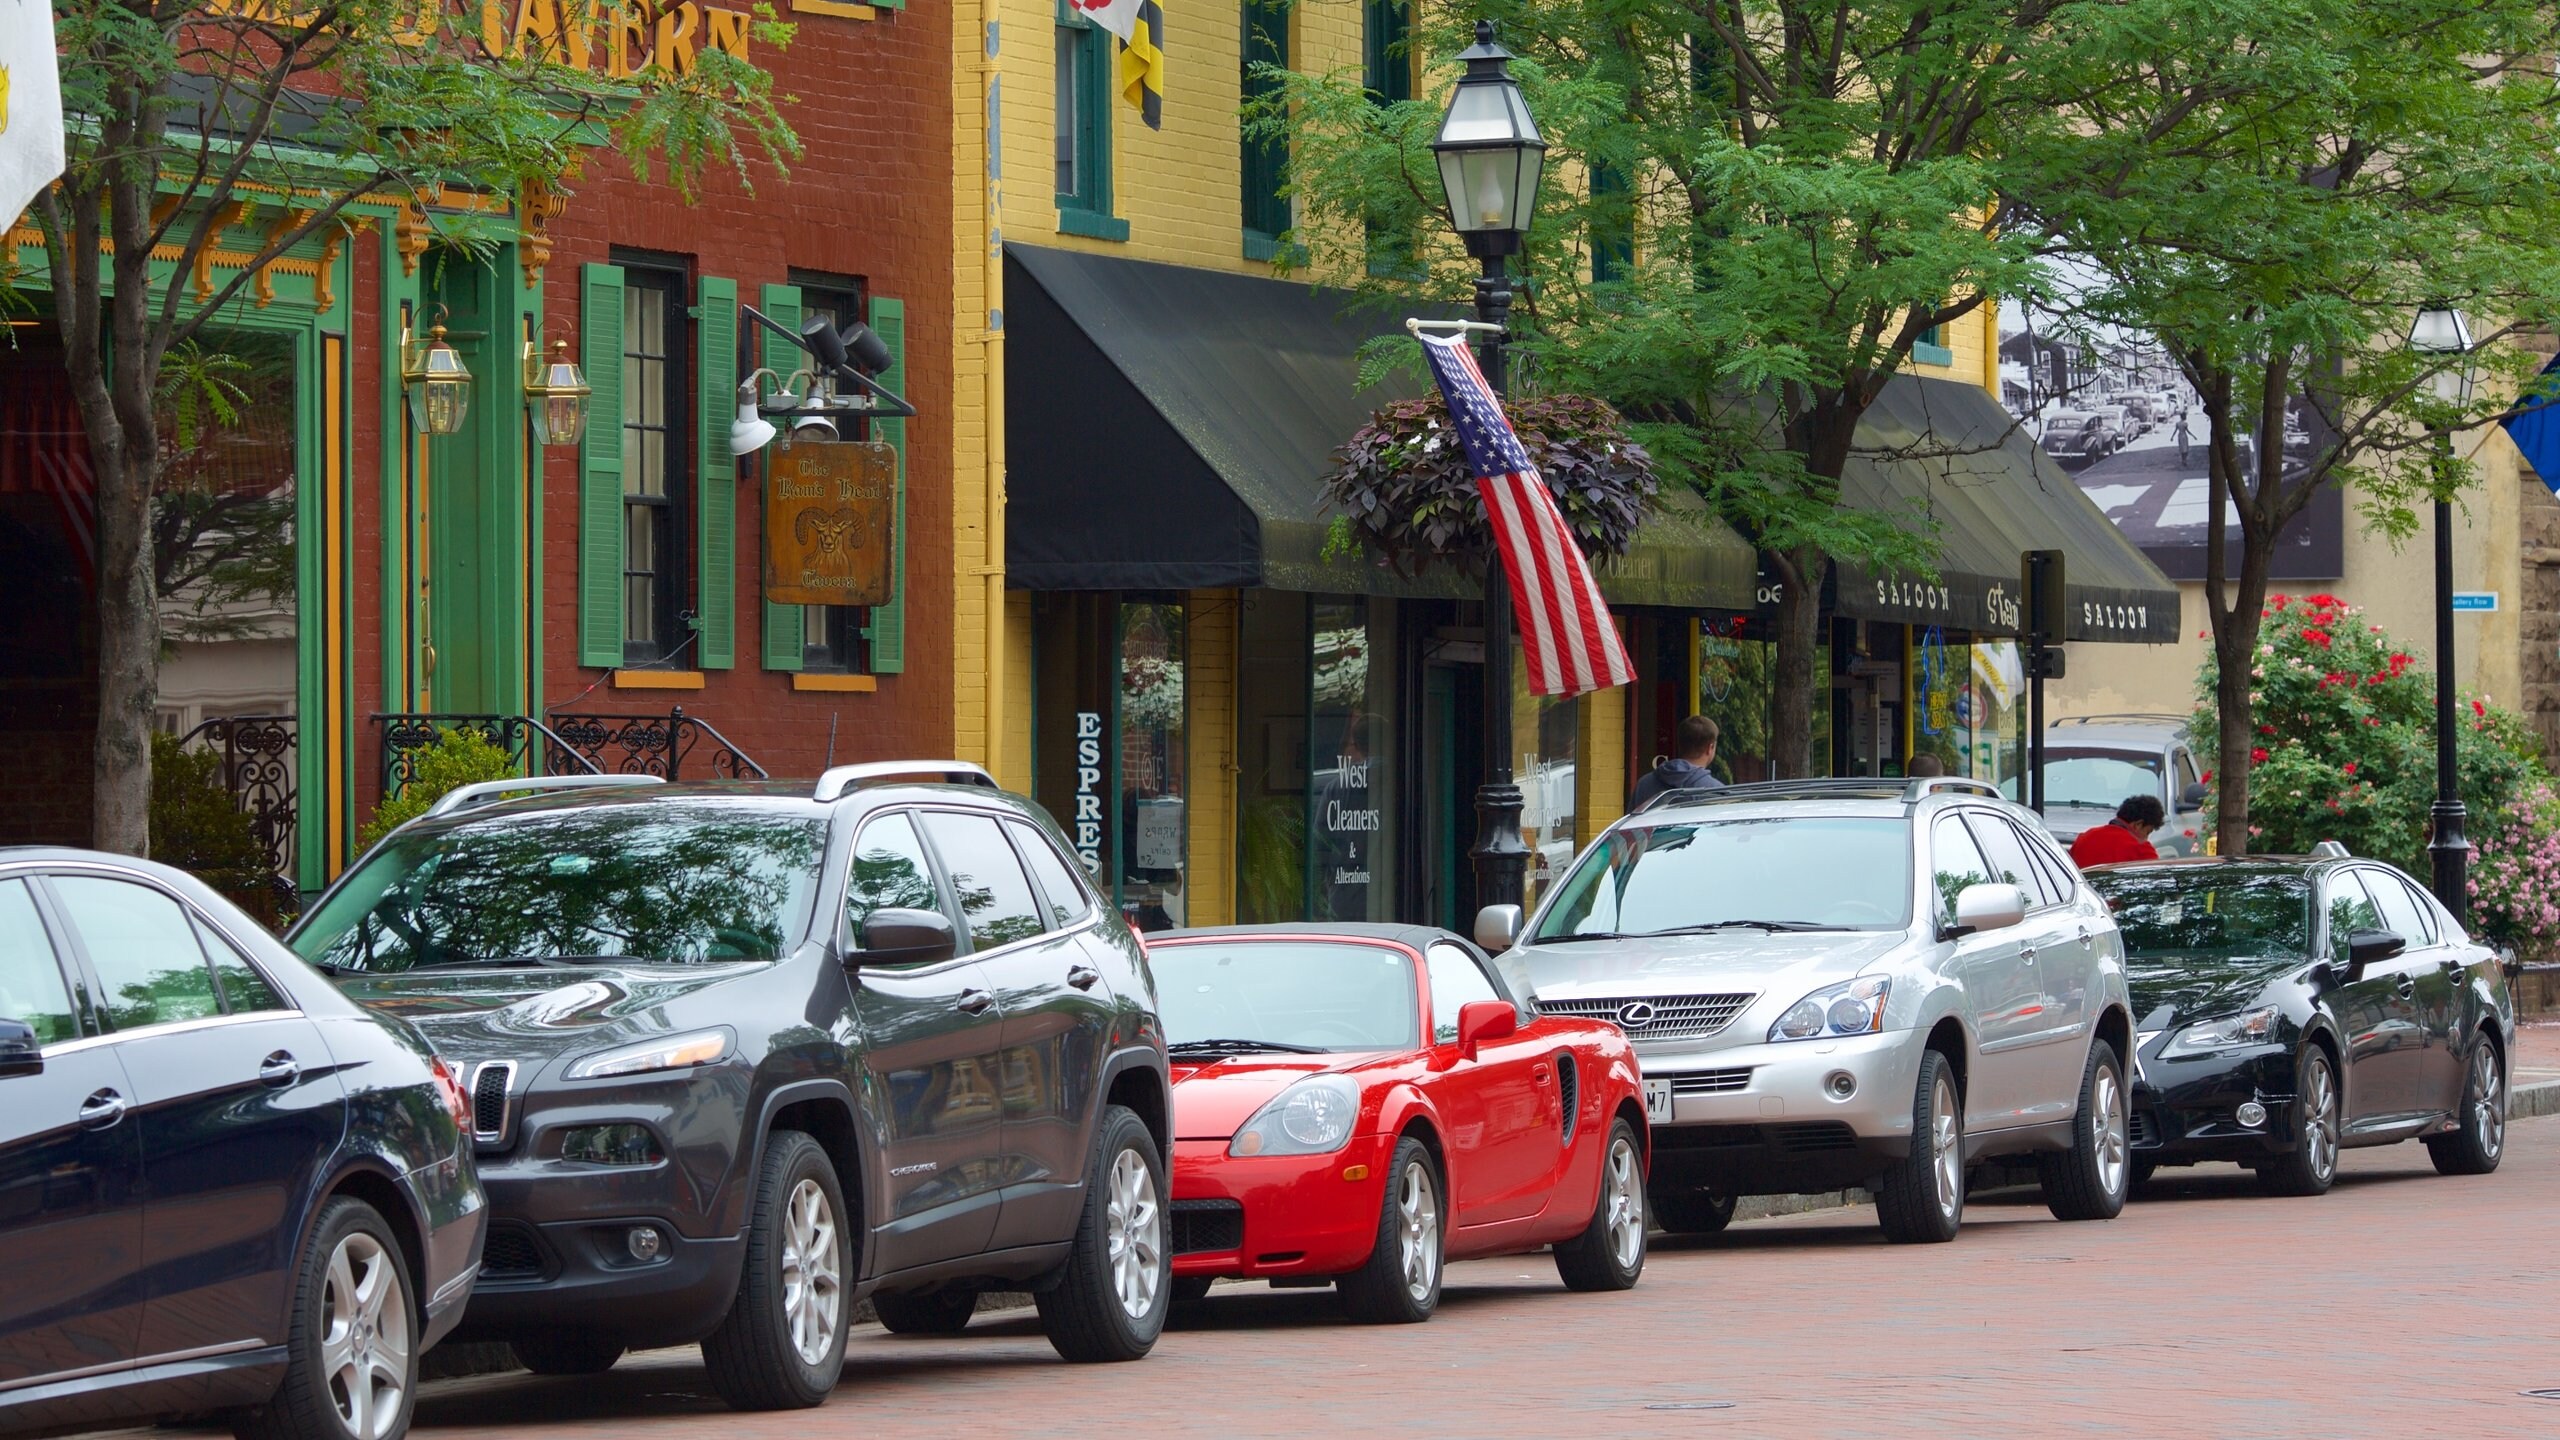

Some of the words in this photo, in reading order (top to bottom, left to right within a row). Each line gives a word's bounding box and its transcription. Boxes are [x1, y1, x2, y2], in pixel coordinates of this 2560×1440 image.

[799, 459, 829, 476] The
[837, 477, 882, 502] Head
[801, 568, 856, 588] Tavern
[1877, 580, 1949, 610] SALOON
[2084, 602, 2147, 630] SALOON
[1336, 755, 1368, 789] West
[1523, 752, 1553, 785] West
[1326, 799, 1379, 832] Cleaners
[1349, 841, 1357, 859] &
[1334, 866, 1371, 885] Alterations
